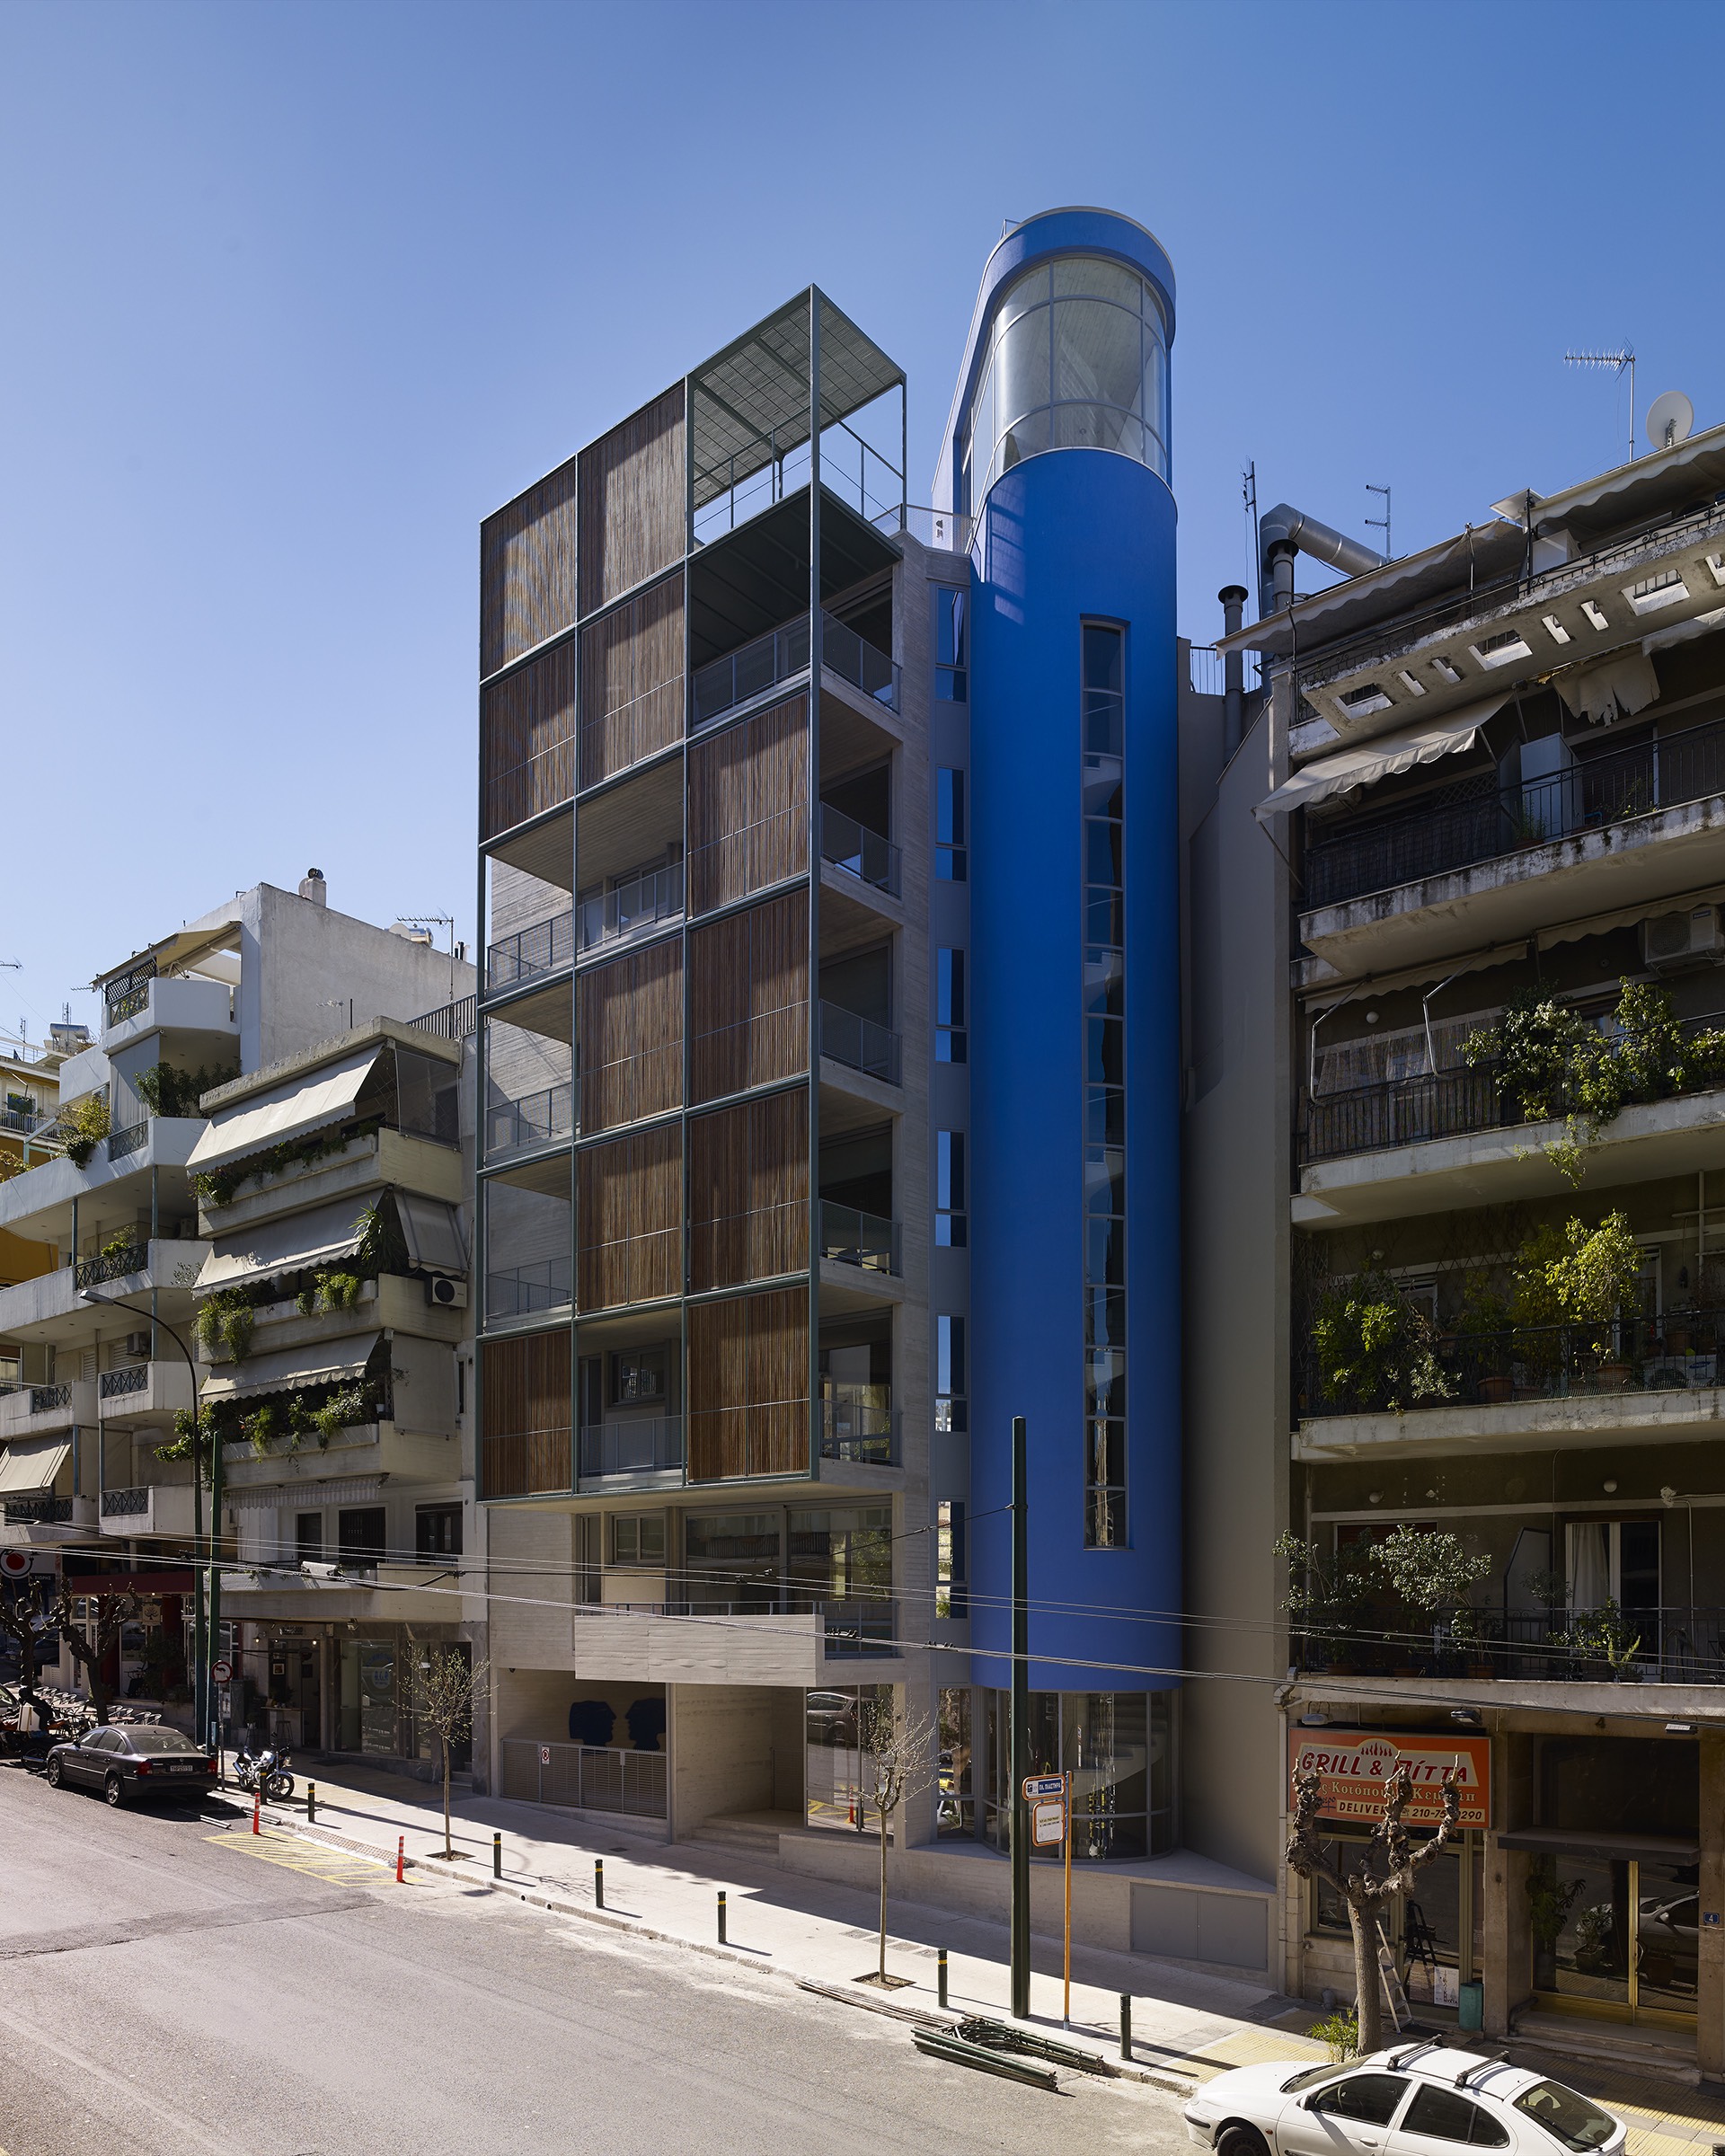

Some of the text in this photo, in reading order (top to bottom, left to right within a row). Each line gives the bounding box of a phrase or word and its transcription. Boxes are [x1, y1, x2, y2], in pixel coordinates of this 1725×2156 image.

[1302, 1752, 1361, 1775] GRILL
[1369, 1760, 1383, 1776] &
[1340, 1802, 1387, 1816] DELIVER
